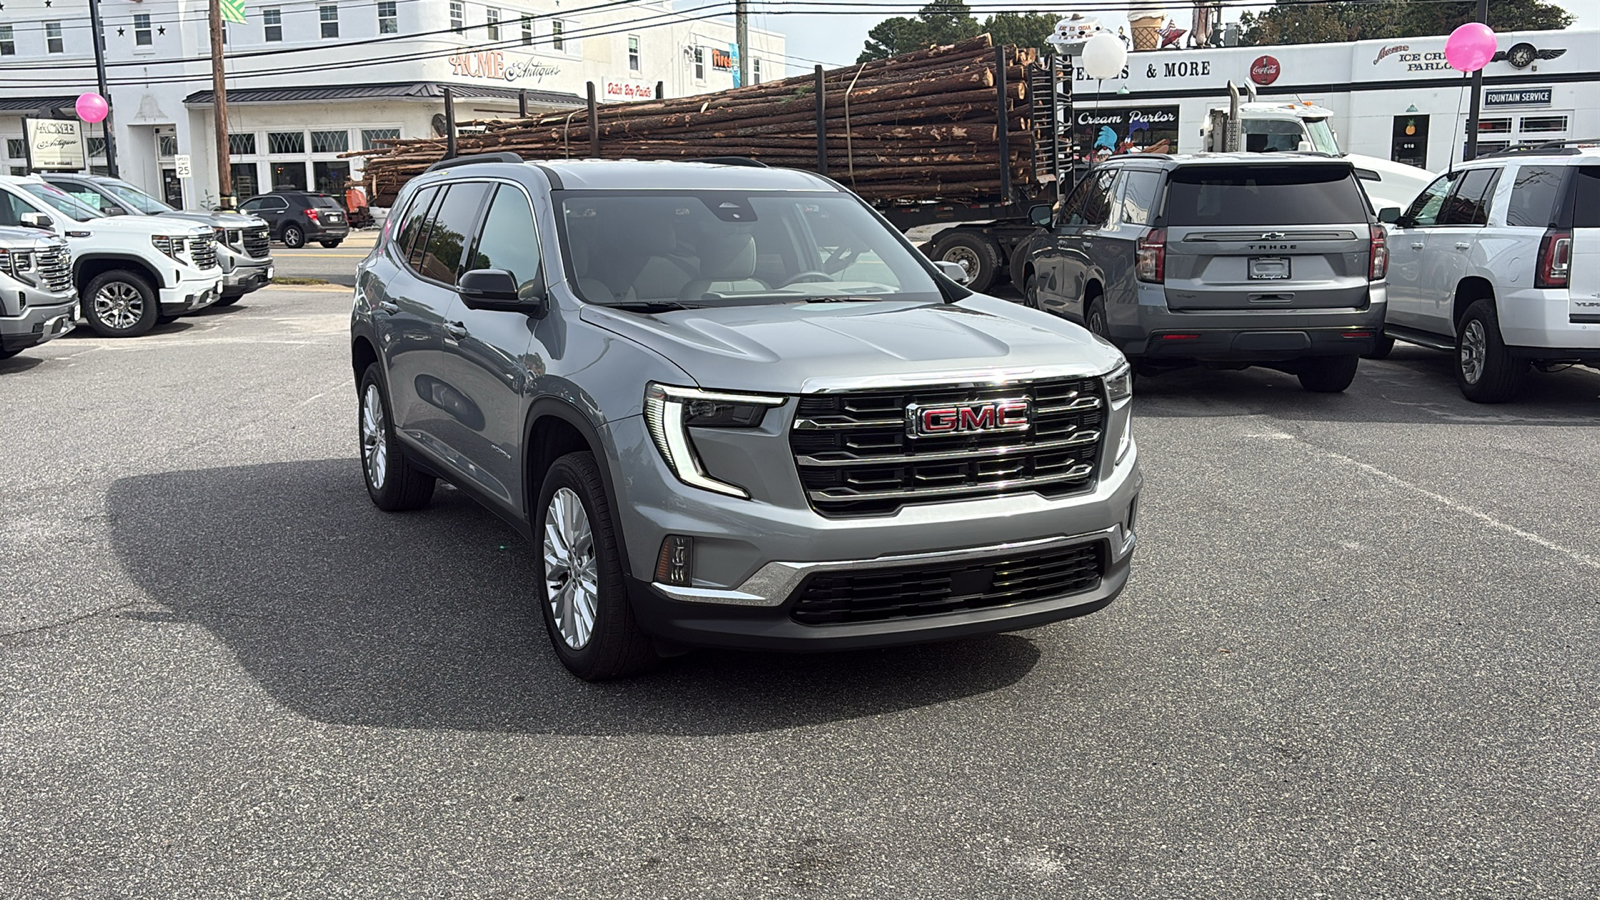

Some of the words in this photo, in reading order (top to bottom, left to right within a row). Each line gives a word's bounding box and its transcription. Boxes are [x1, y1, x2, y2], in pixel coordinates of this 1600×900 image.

[448, 47, 505, 80] ACME
[1399, 53, 1421, 62] ICE
[505, 56, 561, 84] Antiques
[1146, 63, 1157, 79] &
[1164, 60, 1211, 78] MORE
[1407, 62, 1456, 72] PARLO
[608, 82, 623, 95] Dutch
[624, 83, 634, 99] Boy
[635, 84, 652, 98] Paints
[1487, 93, 1520, 103] FOUNTAIN
[1521, 91, 1550, 102] SERVICE
[1078, 112, 1123, 125] Cream
[1128, 110, 1177, 124] Parlor
[178, 166, 190, 175] 25
[922, 402, 1027, 432] GMC
